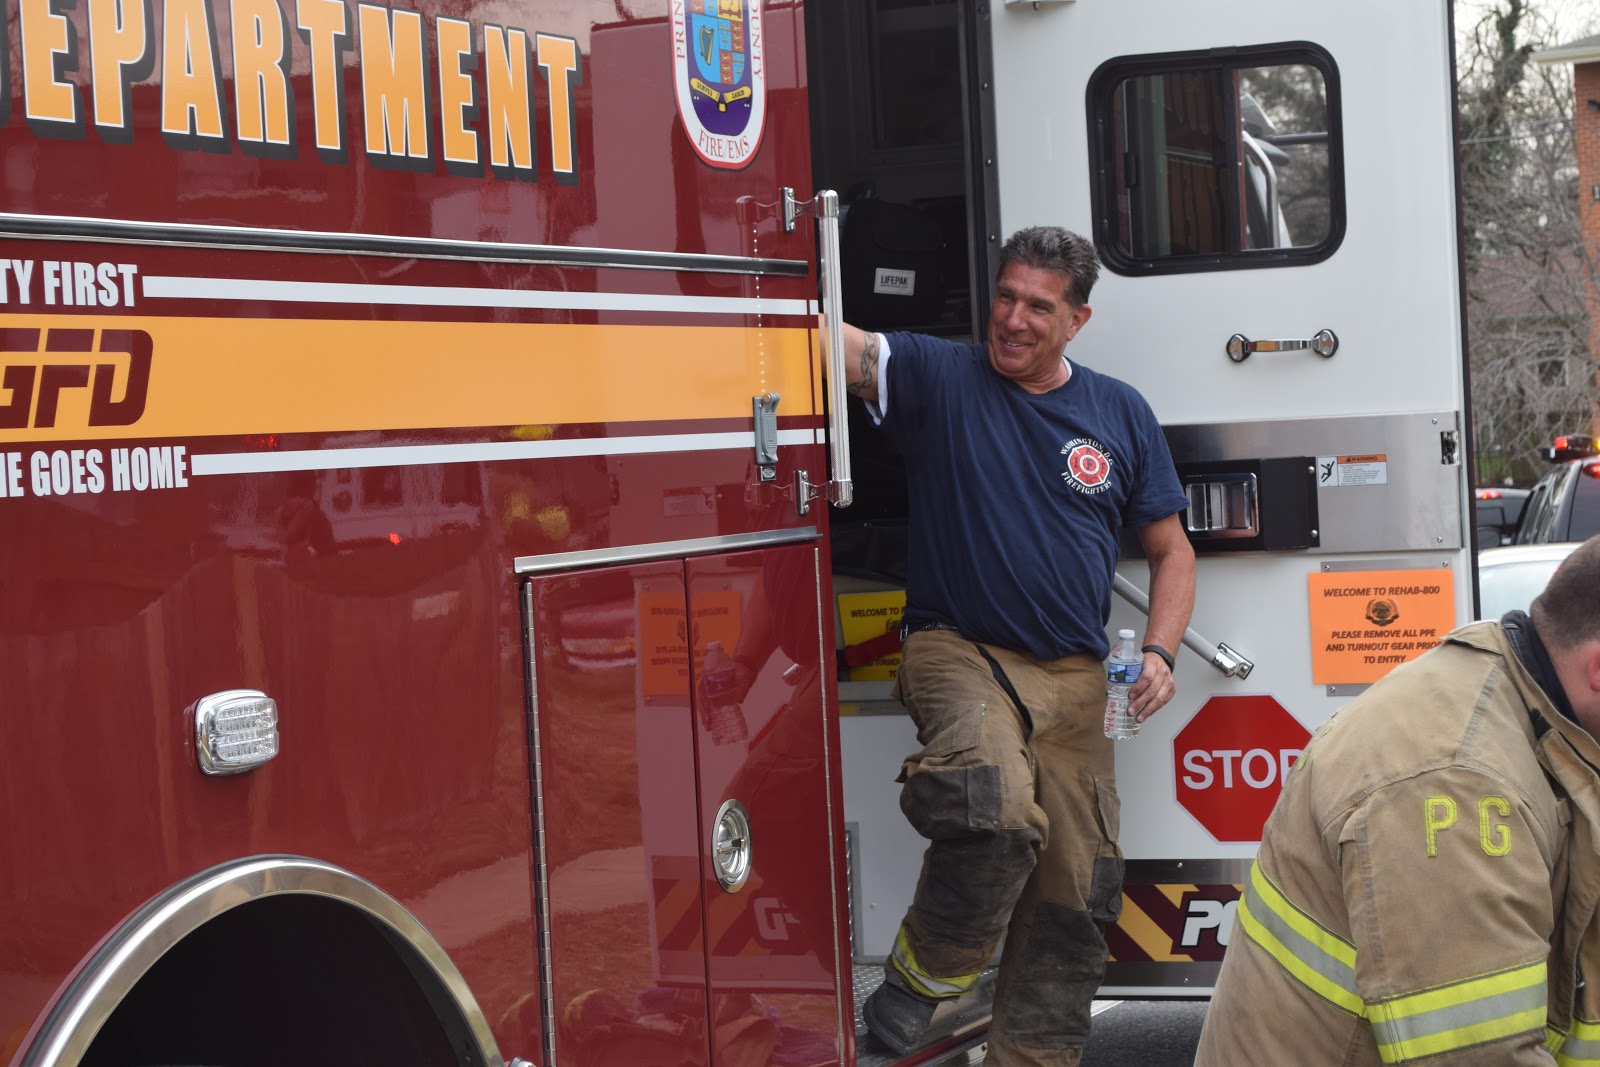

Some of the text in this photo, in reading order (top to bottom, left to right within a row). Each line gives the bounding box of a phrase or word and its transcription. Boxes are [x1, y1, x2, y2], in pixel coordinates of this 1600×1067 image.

[698, 128, 750, 160] FIRE/EMS
[43, 260, 137, 307] FIRST
[880, 275, 909, 285] LIFEPAK
[31, 449, 105, 497] GOES
[111, 446, 188, 492] HOME
[1061, 471, 1112, 495] FIREFIGHTERS
[1323, 586, 1440, 597] WELCOME TO REHAB-800
[850, 608, 888, 618] WELCOME
[888, 607, 900, 615] TO
[1331, 629, 1436, 639] PLEASE REMOVE ALL PPE
[1325, 643, 1345, 652] AND
[1347, 642, 1389, 651] TURNOUT
[1391, 642, 1414, 651] GEAR
[1363, 655, 1407, 664] TO ENTRY
